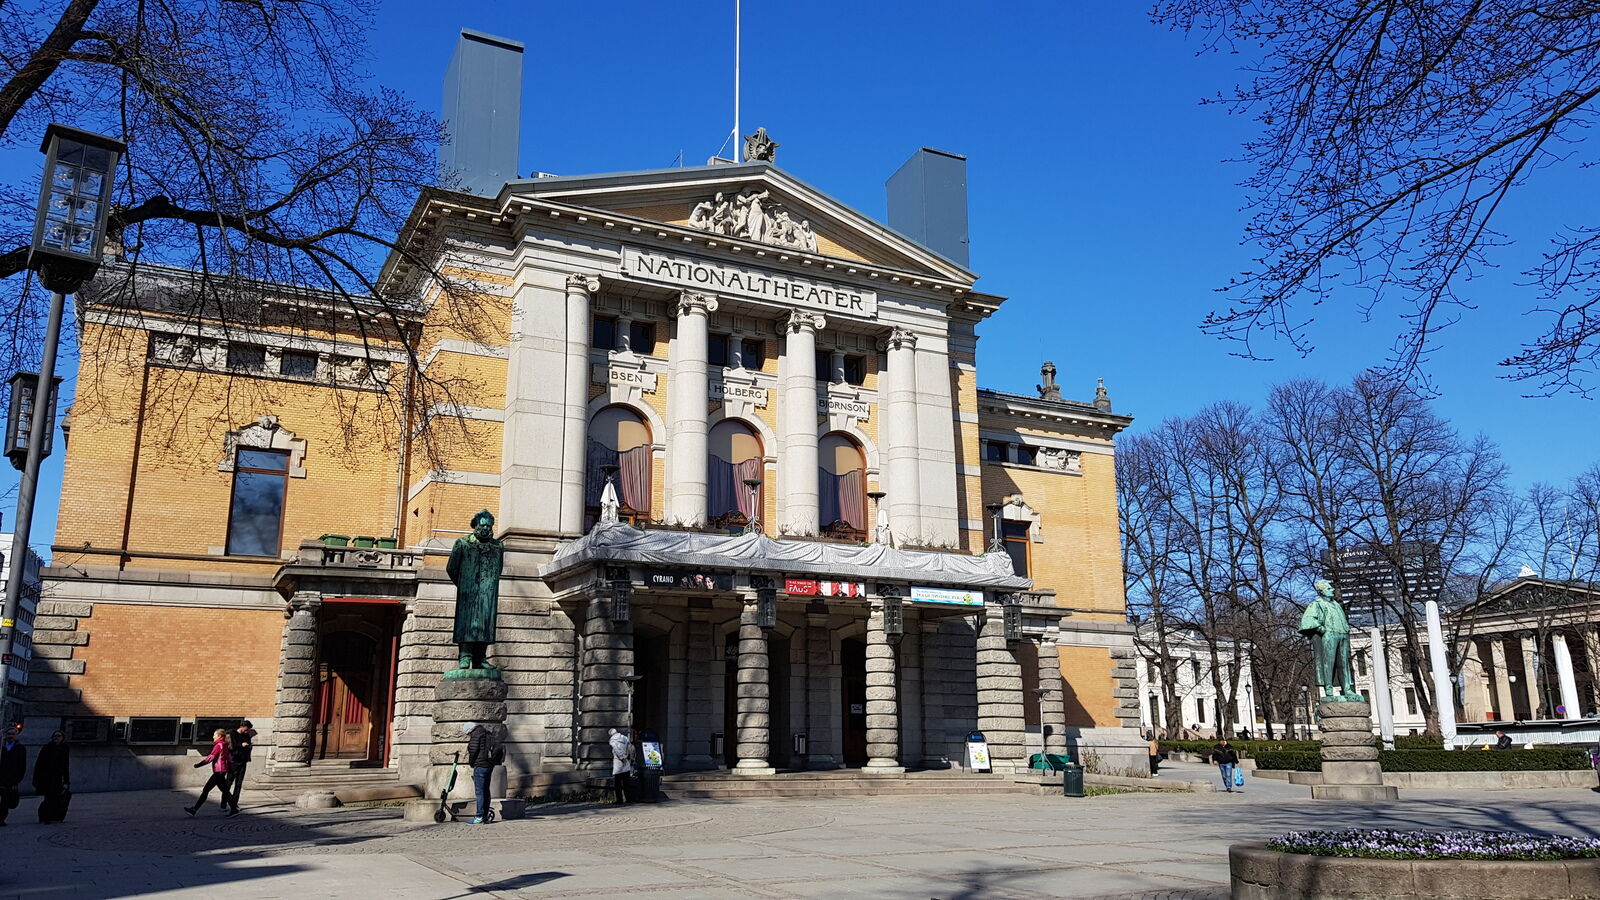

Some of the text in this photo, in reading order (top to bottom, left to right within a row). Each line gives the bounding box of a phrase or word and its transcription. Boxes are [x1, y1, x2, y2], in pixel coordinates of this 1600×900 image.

[638, 256, 862, 311] NATIONALTHEATER
[714, 385, 762, 399] HOLBERG
[652, 574, 675, 583] CYRANO
